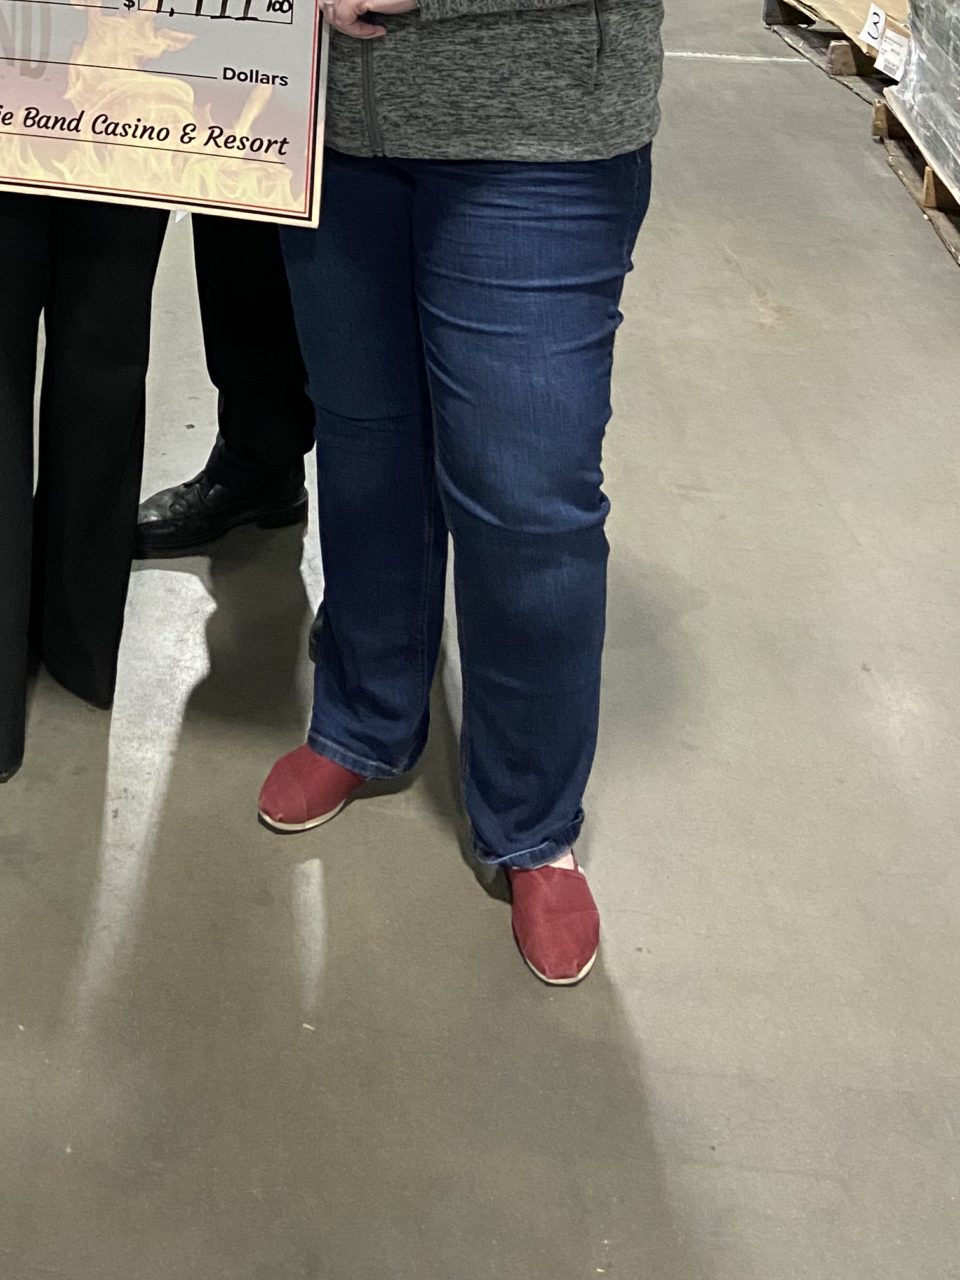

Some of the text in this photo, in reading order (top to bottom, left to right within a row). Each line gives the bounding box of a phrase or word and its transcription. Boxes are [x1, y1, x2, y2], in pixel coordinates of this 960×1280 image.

[222, 66, 289, 86] Dollars
[23, 106, 86, 134] Band
[91, 113, 170, 142] Casino
[179, 122, 198, 144] &
[203, 125, 290, 156] Resort
